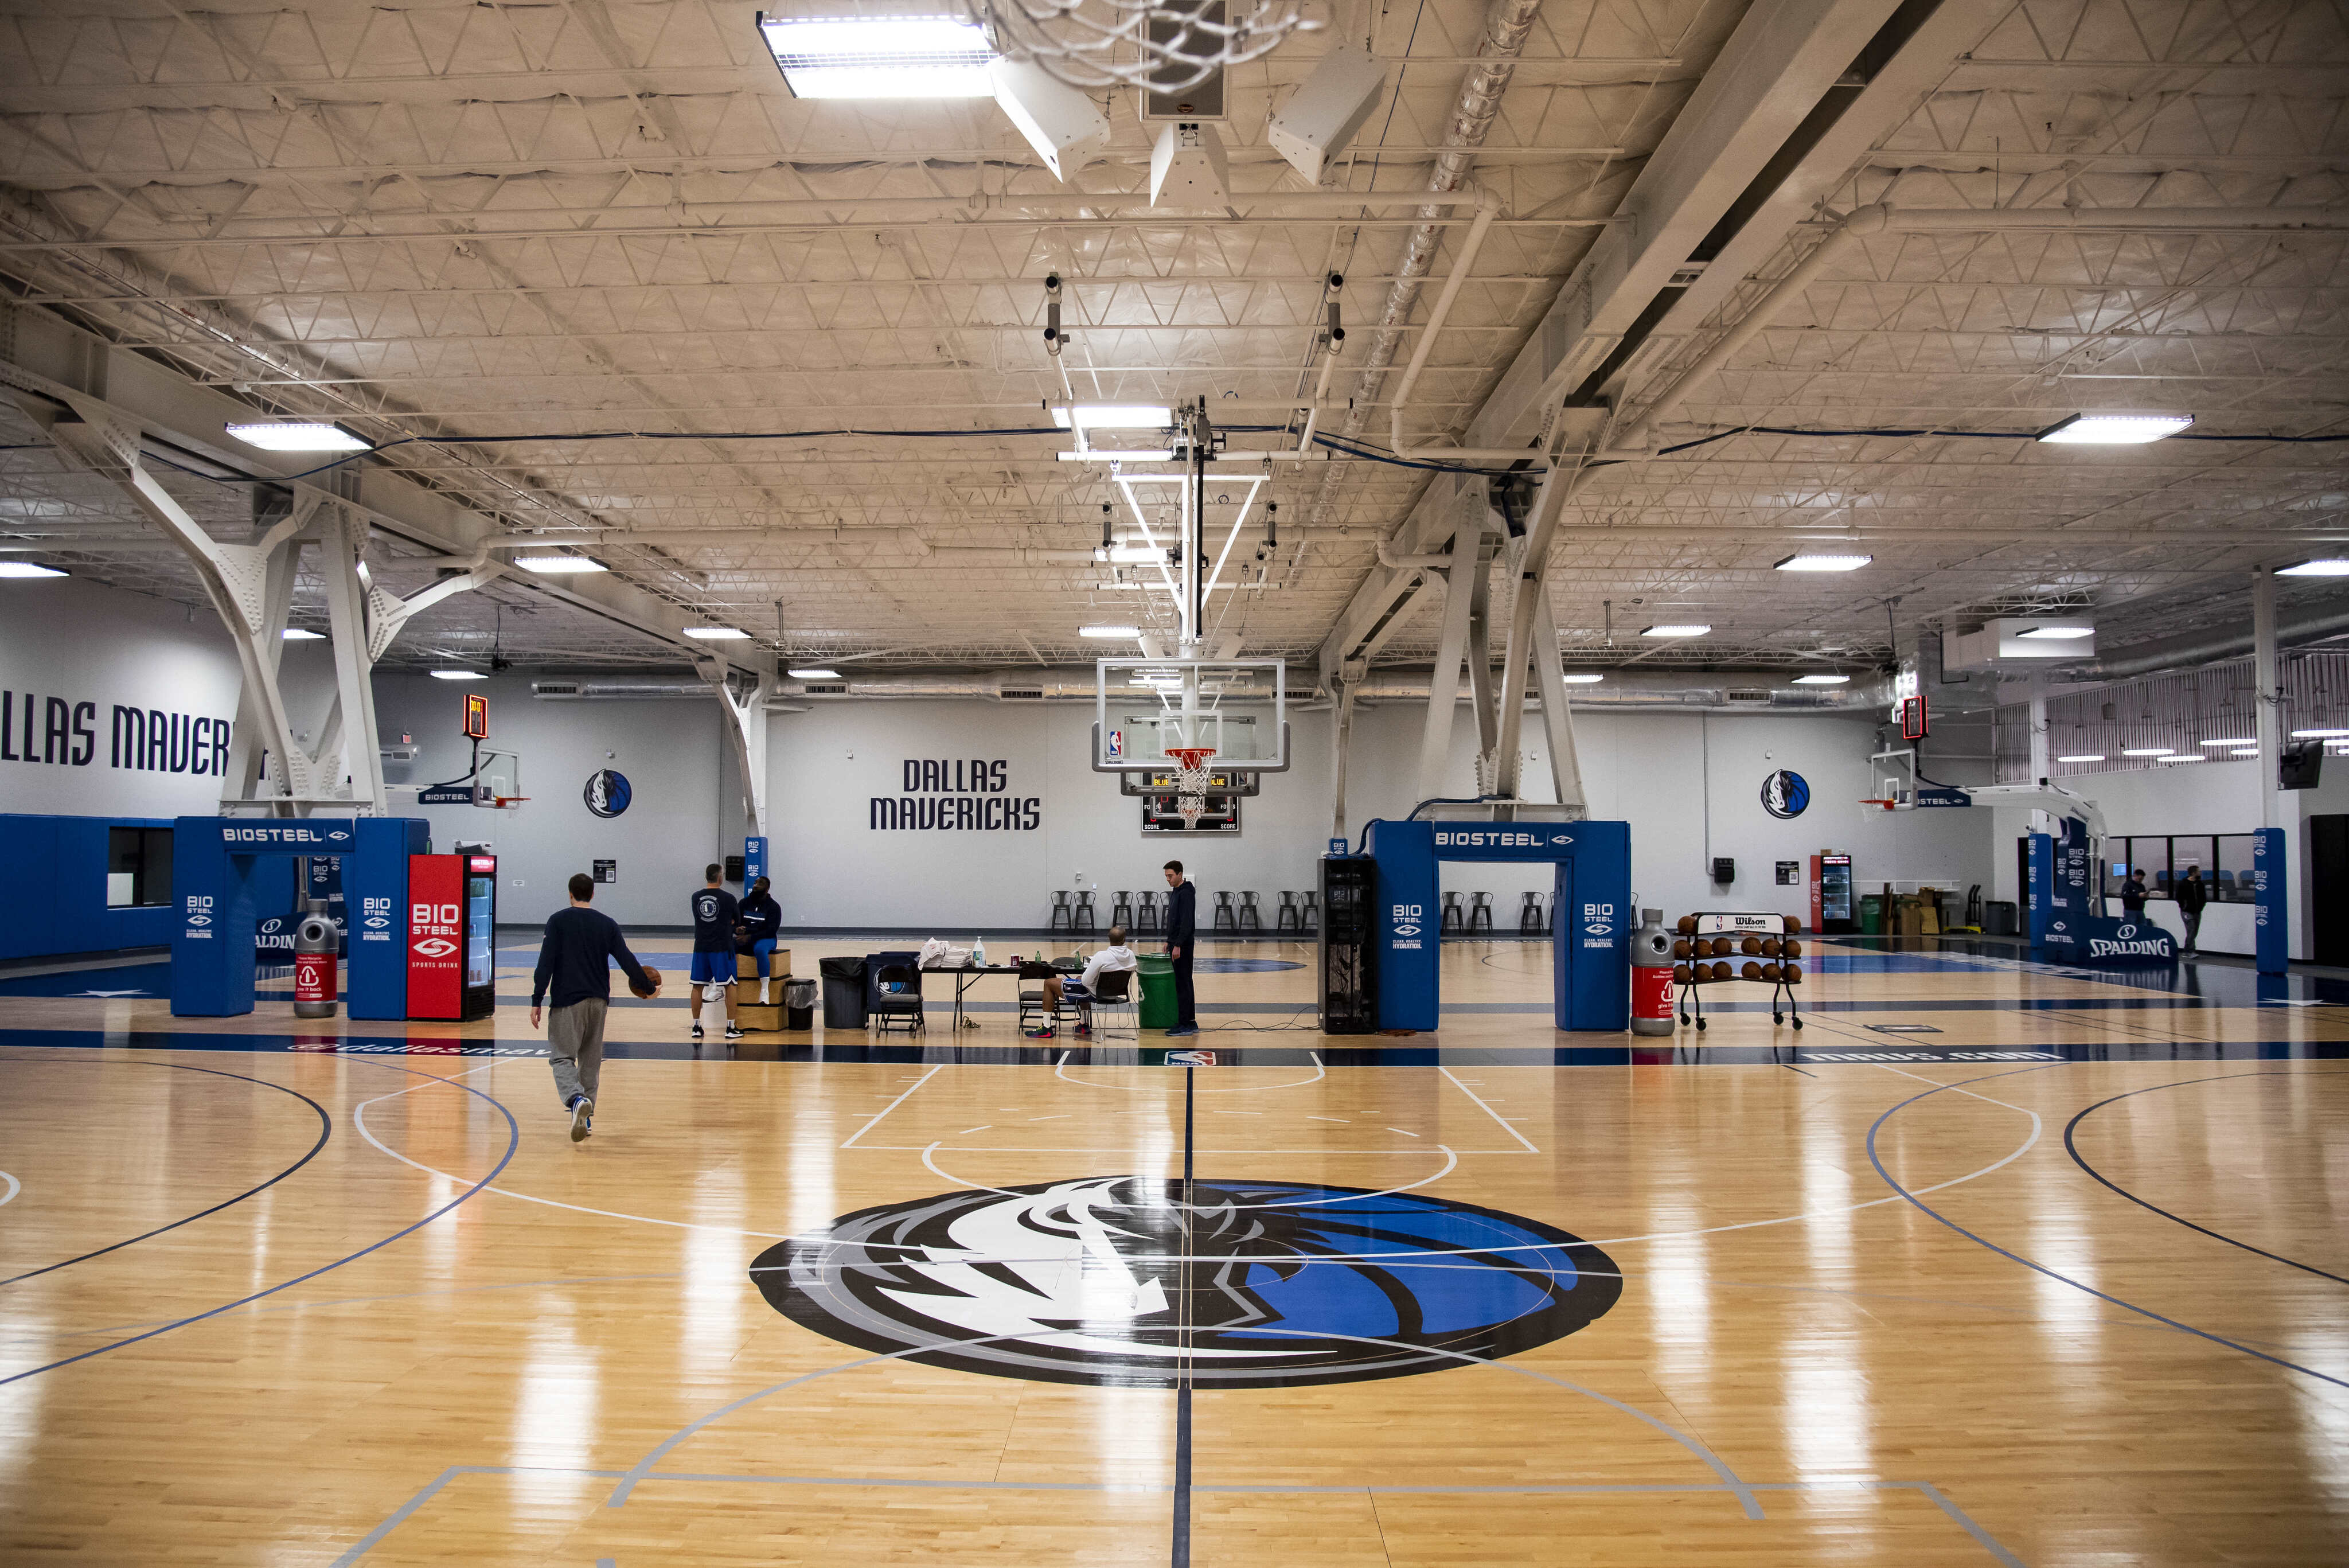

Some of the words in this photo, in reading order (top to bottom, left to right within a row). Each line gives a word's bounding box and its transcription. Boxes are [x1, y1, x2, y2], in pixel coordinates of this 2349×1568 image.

[1, 690, 96, 766] LLAS
[111, 704, 230, 777] MAVER
[903, 759, 1007, 792] DALLAS
[870, 797, 1040, 830] MAVERICKS
[223, 828, 323, 842] BIOSTEEL
[1435, 832, 1544, 846] BIOSTEEL
[187, 896, 213, 907] BIO
[364, 898, 390, 910] BIO
[412, 904, 459, 923] BIO
[1393, 904, 1422, 916] BIO
[1585, 904, 1613, 915] BIO
[1735, 916, 1766, 925] Wilson
[412, 926, 459, 935] STEEL
[255, 935, 296, 950] ALDIN
[2045, 934, 2074, 943] BIOSTEEL
[2089, 938, 2171, 958] SPALDING
[287, 1042, 552, 1055] @dallasmav
